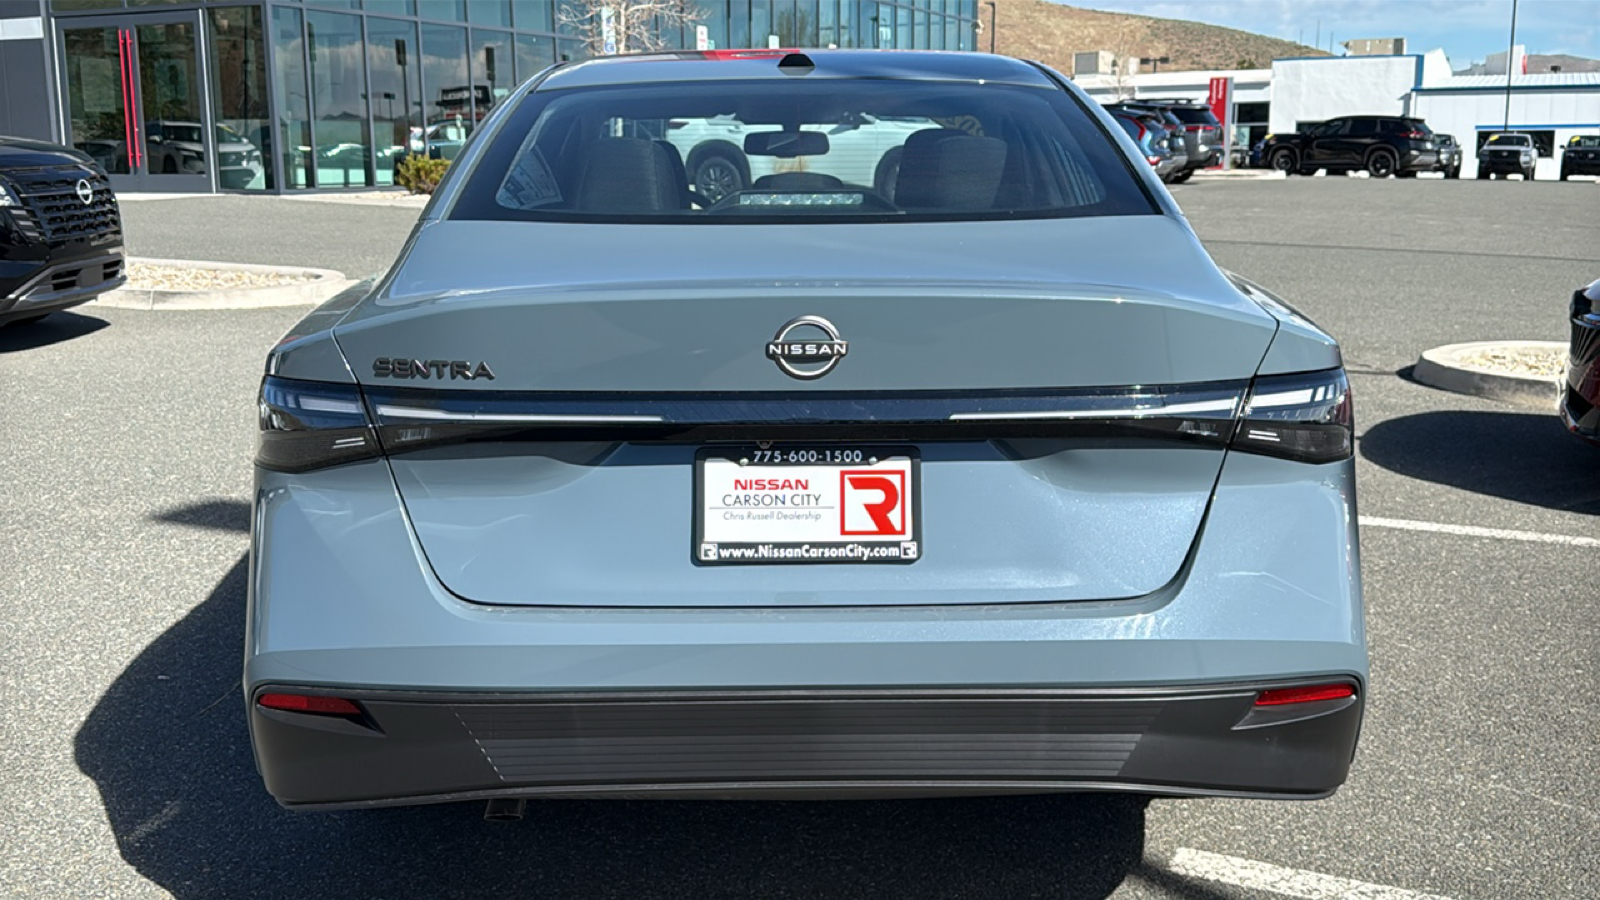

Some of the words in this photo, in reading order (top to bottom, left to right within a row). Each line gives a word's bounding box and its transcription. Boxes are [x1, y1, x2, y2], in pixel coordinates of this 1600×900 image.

[769, 344, 846, 355] NISSAN
[372, 357, 496, 381] SENTRA
[753, 450, 863, 463] 775-600-1500
[734, 478, 810, 491] NISSAN
[722, 493, 786, 507] CARSON
[790, 493, 822, 507] CITY
[723, 510, 745, 521] Chris
[746, 510, 775, 521] Russell
[776, 510, 822, 523] Dealership
[719, 543, 900, 561] www.NissanCarsonCity.com
